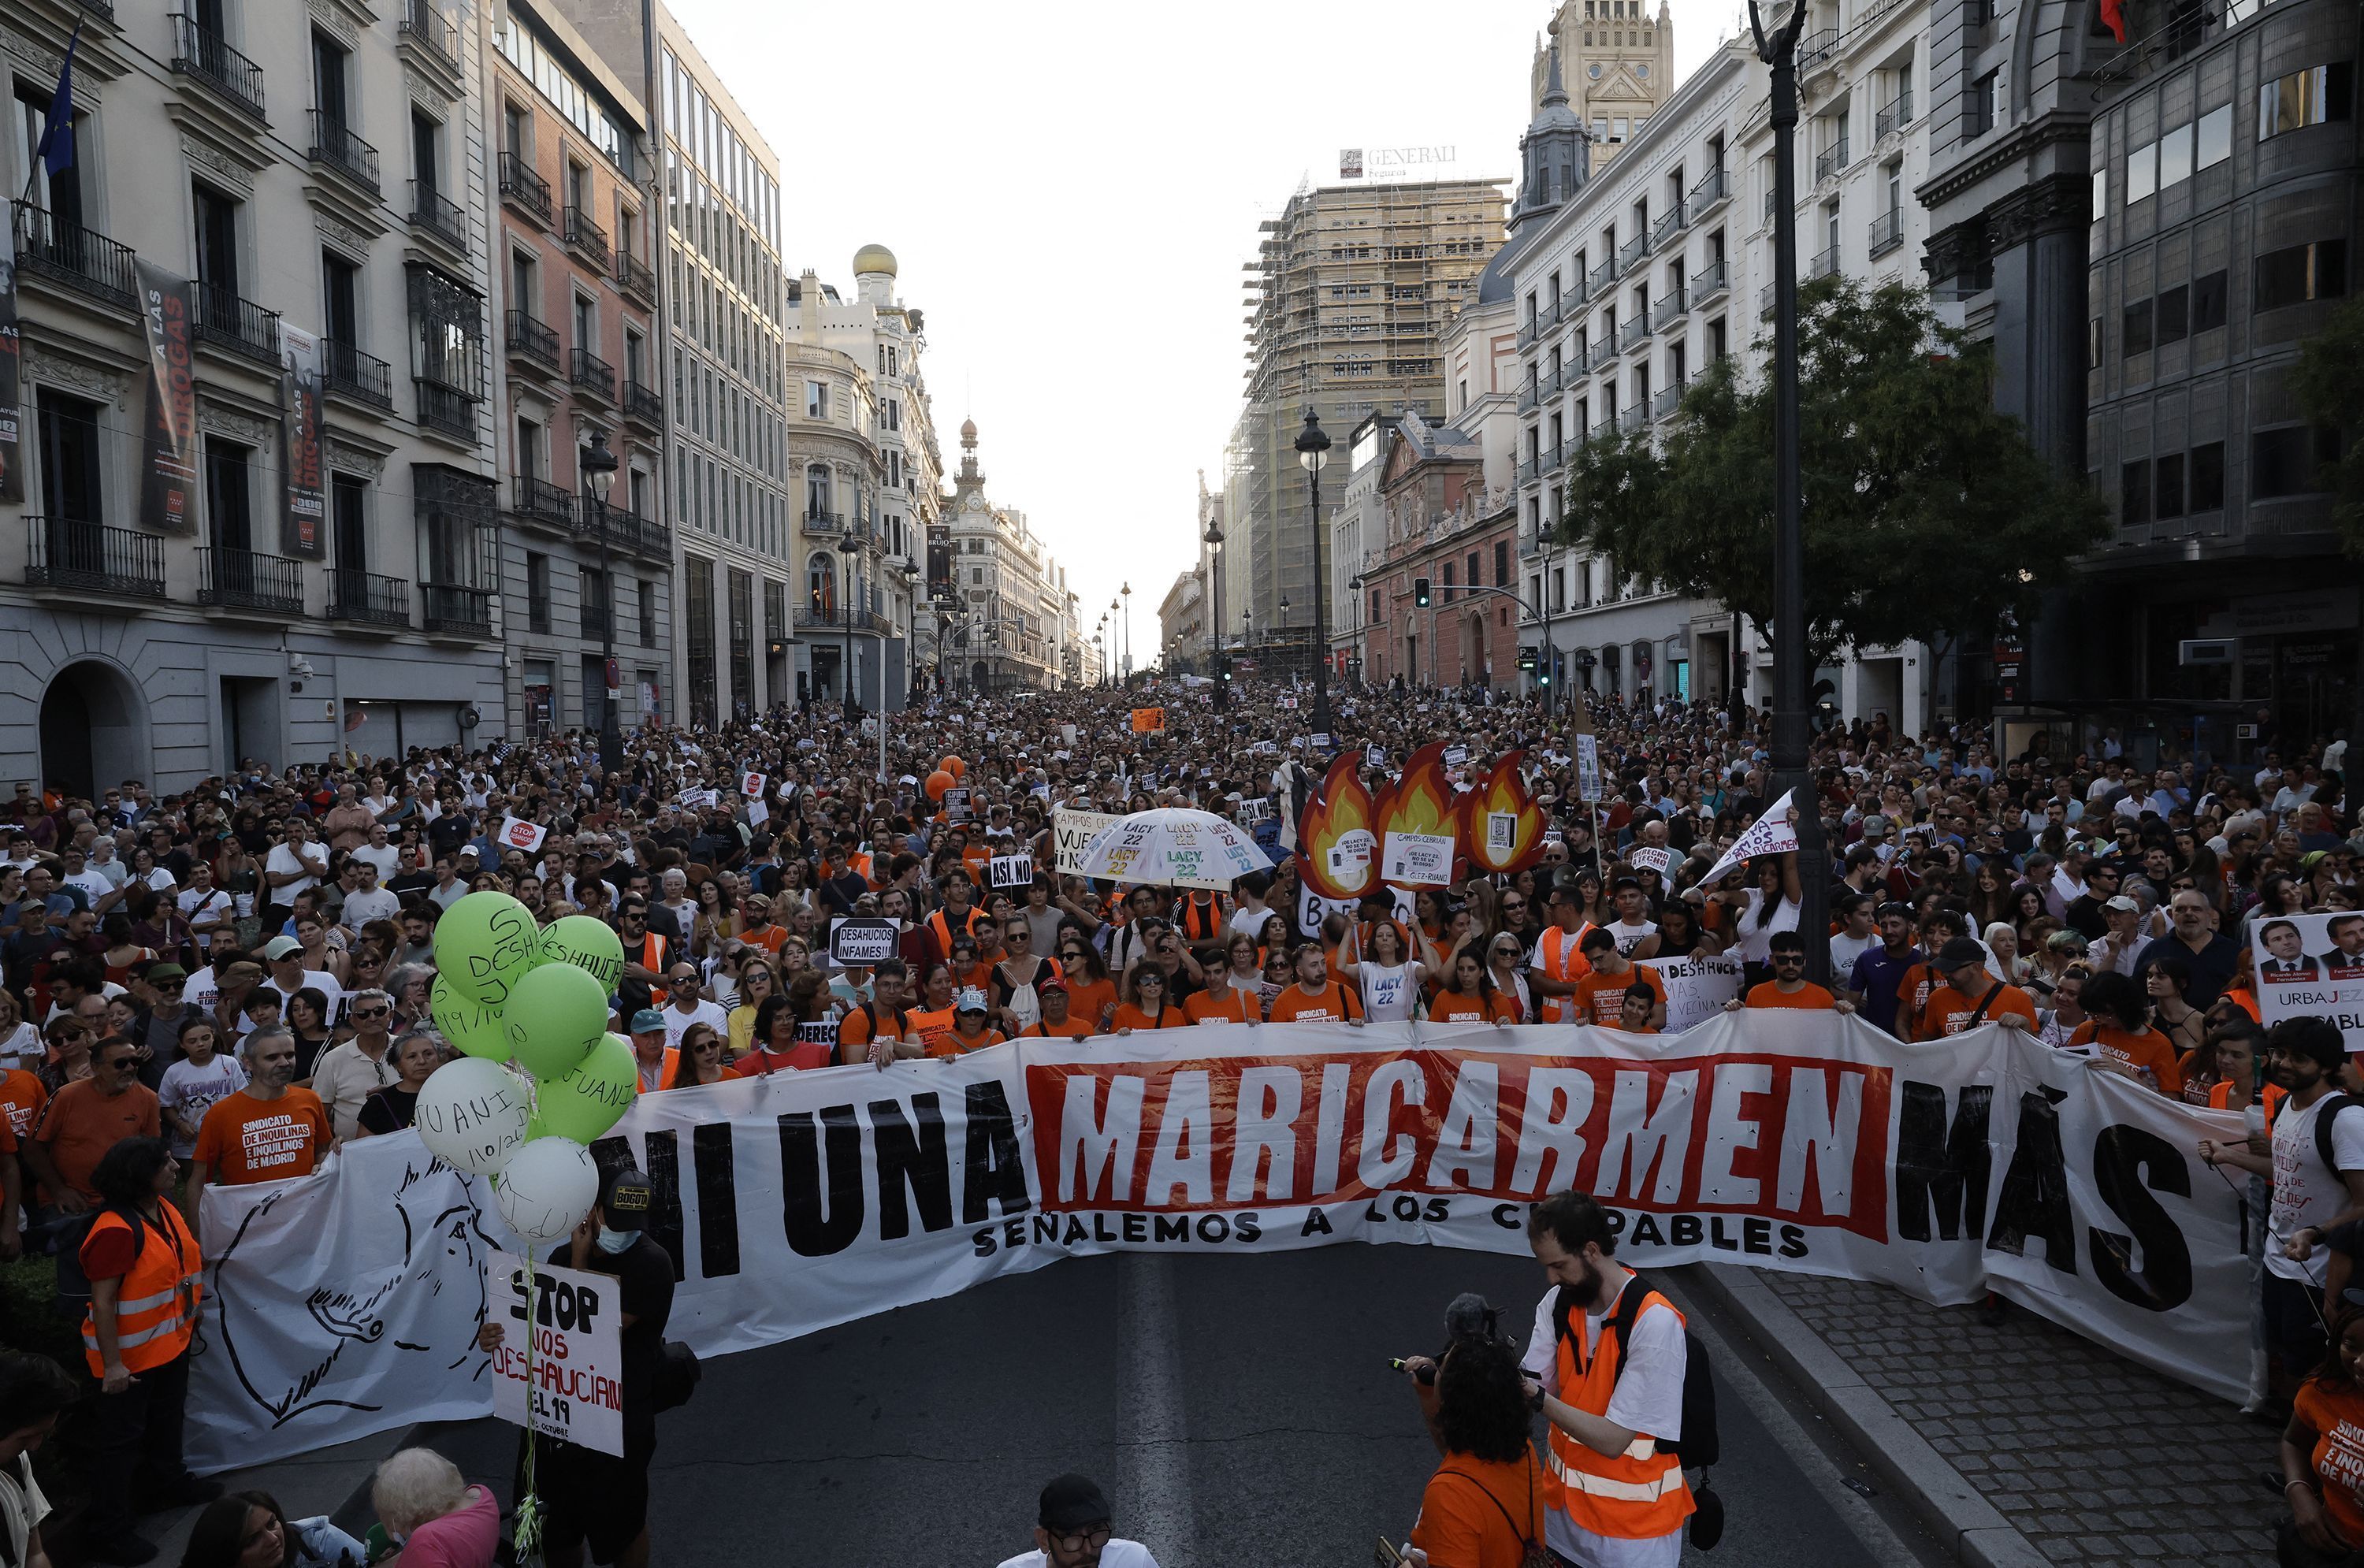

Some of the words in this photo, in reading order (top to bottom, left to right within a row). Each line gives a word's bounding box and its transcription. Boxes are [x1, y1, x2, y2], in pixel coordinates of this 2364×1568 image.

[1369, 146, 1455, 165] GENERALI
[1368, 168, 1407, 177] Seguros
[149, 289, 163, 337] LAS
[156, 344, 165, 359] A
[164, 295, 191, 437] DROGAS
[294, 390, 303, 419] LAS
[296, 426, 303, 435] A
[303, 392, 320, 488] DROGAS
[1520, 648, 1526, 657] P
[2289, 654, 2329, 663] DEPORTE
[680, 786, 702, 797] DERECHO
[687, 791, 704, 801] TECHO
[1257, 801, 1269, 819] NO
[1055, 812, 1091, 828] CAMPOS
[512, 825, 535, 836] STOP
[510, 832, 533, 844] DESAHUCIOS
[1123, 834, 1143, 845] 22
[1173, 833, 1196, 845] 22
[1397, 834, 1421, 842] CAMPOS
[1422, 835, 1447, 845] CEBRIÁN
[1634, 848, 1669, 860] DERECHO
[1638, 855, 1667, 867] TECHO
[993, 856, 1014, 886] ASÍ,
[1015, 860, 1031, 882] NO
[1107, 861, 1128, 875] 22
[1175, 864, 1198, 877] 22
[1237, 857, 1254, 871] 22
[1410, 871, 1448, 882] GLEZ-RUANO
[192, 901, 199, 910] I
[841, 928, 893, 942] DESAHUCIOS
[539, 923, 626, 986] DESHAUCIA
[838, 946, 891, 958] INFAMES!!!
[1378, 992, 1394, 1005] 22
[2279, 988, 2364, 1006] URBAJEZ
[1296, 1009, 1327, 1019] SINDICATO
[1677, 1000, 1716, 1016] VECINA
[1449, 1013, 1480, 1021] SINDICATO
[916, 1024, 946, 1034] SINDICATO
[1663, 1020, 1699, 1033] SOMOS
[1947, 1024, 1957, 1034] DE
[870, 1044, 880, 1054] DE
[563, 1068, 634, 1107] JUANI
[414, 1089, 514, 1134] JUANI
[242, 1114, 292, 1132] SINDICATO
[244, 1133, 258, 1146] DE
[258, 1124, 309, 1143] INQUILINAS
[246, 1148, 253, 1158] E
[253, 1138, 304, 1157] INQUILINOS
[247, 1158, 259, 1170] DE
[260, 1152, 296, 1169] MADRID
[777, 1079, 1033, 1258] UNA
[1058, 1058, 1865, 1218] MARICARMEN
[1895, 1079, 2194, 1313] MÁS
[2291, 1176, 2306, 1187] DE
[617, 1192, 647, 1205] BOGOTA
[972, 1209, 1262, 1258] SEÑALEMOS
[1300, 1207, 1333, 1237] A
[1365, 1195, 1449, 1223] LOS
[510, 1270, 599, 1335] STOP
[533, 1326, 569, 1359] NOS
[492, 1344, 623, 1413] DESHAUCIAN
[531, 1390, 550, 1418] EL
[551, 1396, 571, 1425] 19
[542, 1422, 569, 1438] OCTUBRE
[2325, 1447, 2337, 1462] E
[2320, 1460, 2340, 1481] DE
